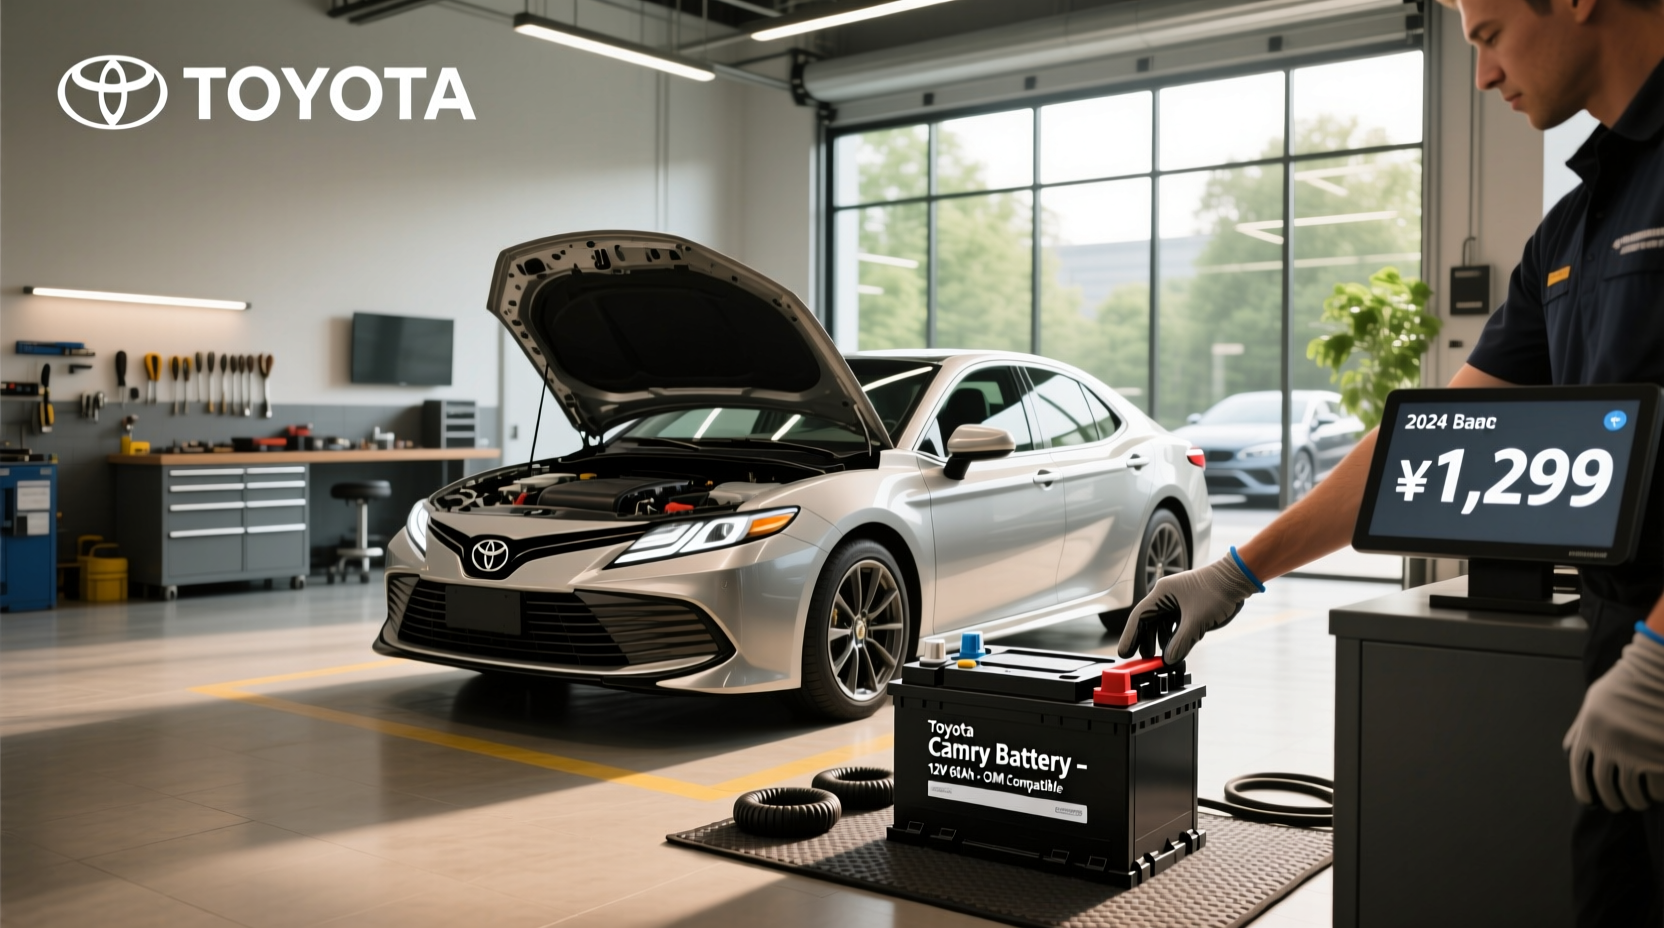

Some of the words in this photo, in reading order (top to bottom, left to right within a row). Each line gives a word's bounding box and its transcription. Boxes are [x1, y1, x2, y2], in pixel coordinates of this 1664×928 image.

[1404, 413, 1448, 430] 2024
[1395, 447, 1614, 515] ¥1,299
[928, 719, 974, 740] Toyota
[928, 736, 991, 768] Camry
[995, 742, 1072, 780] Battery
[927, 762, 948, 776] 12V
